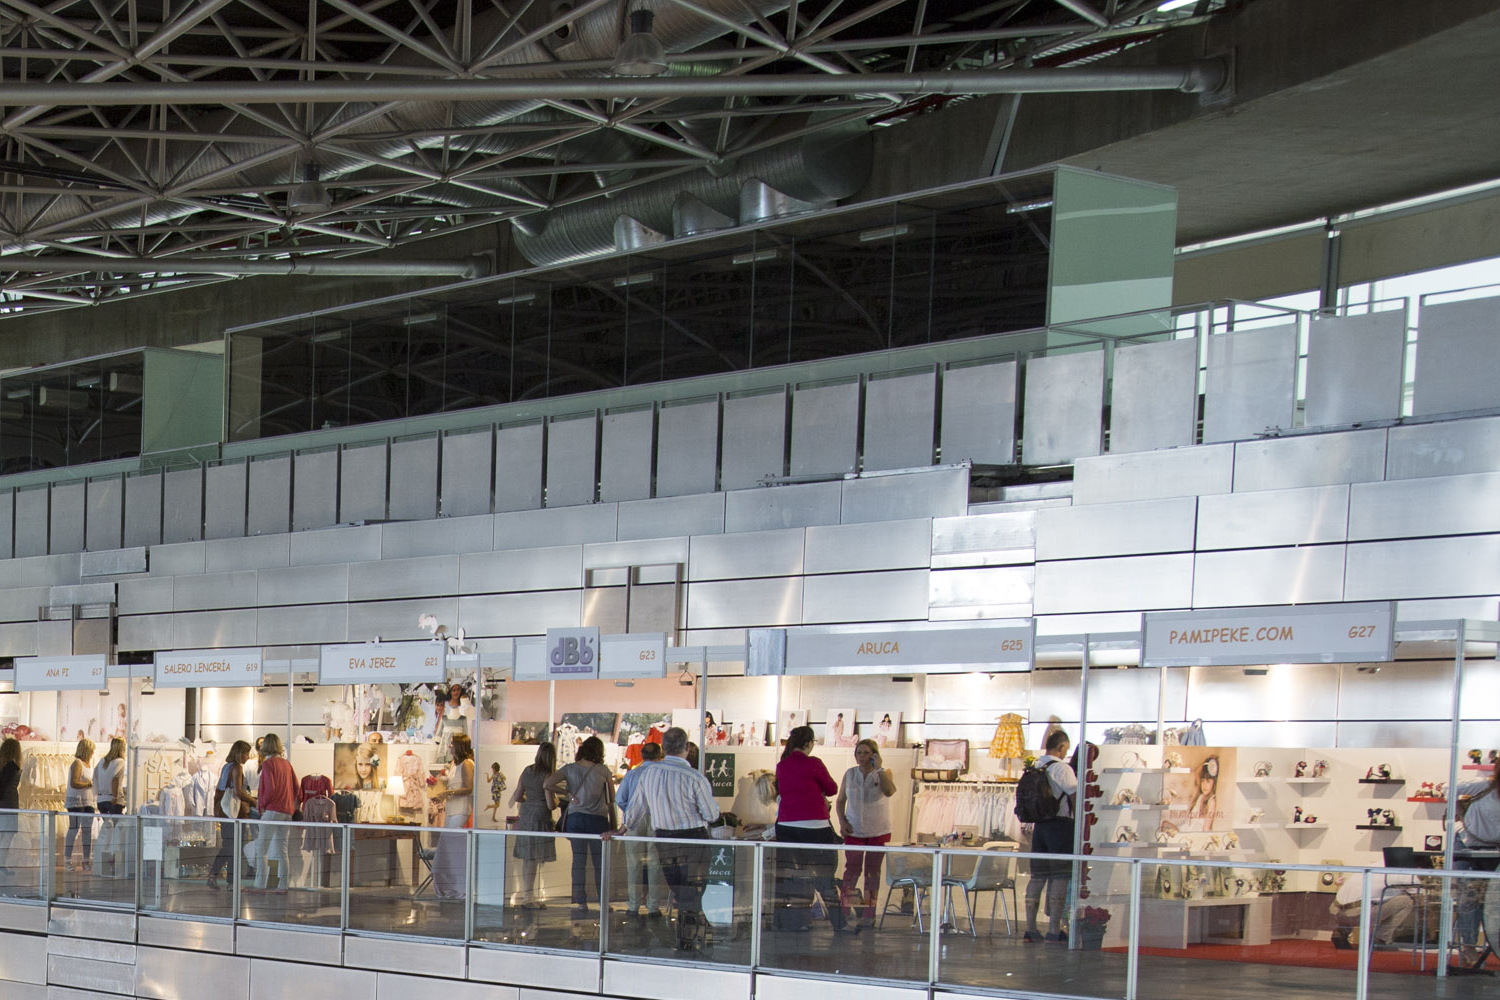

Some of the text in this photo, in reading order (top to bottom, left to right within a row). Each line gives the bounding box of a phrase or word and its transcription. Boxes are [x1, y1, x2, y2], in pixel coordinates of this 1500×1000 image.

[1169, 625, 1376, 644] PAMIPEKE.COM G27
[857, 640, 1023, 655] ARUCA G25
[349, 656, 438, 669] EVA JEREZ G21
[639, 650, 656, 661] G23
[46, 668, 60, 677] ANA
[91, 667, 102, 676] G17
[164, 659, 258, 674] SALERO LENCERÍA G19
